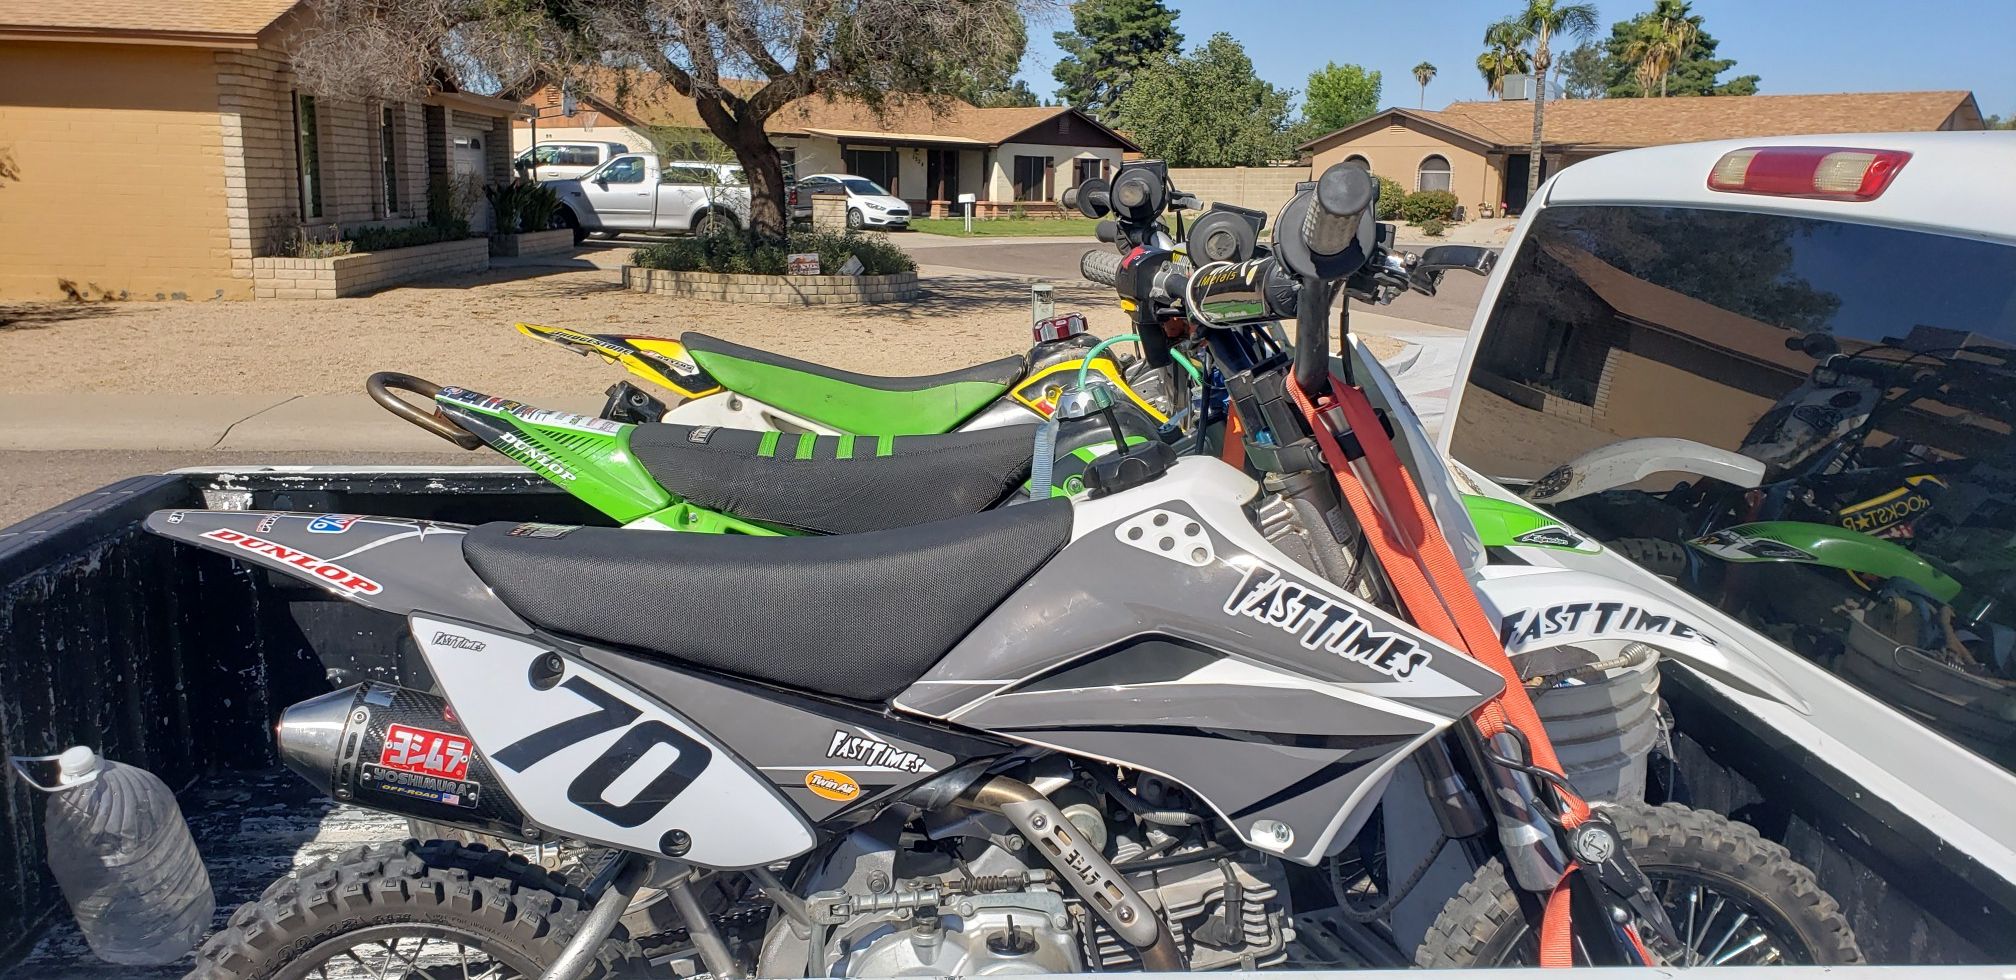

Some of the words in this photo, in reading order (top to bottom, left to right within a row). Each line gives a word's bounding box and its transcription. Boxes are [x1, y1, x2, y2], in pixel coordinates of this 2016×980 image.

[500, 432, 577, 481] DUNLOP
[211, 530, 379, 593] DUNLOP
[389, 730, 465, 773] ヨシムラ
[491, 674, 713, 828] 70
[373, 767, 467, 796] YOSHIMURA
[381, 784, 439, 799] OFF-ROAD
[811, 774, 838, 790] Twin
[837, 781, 857, 795] Air
